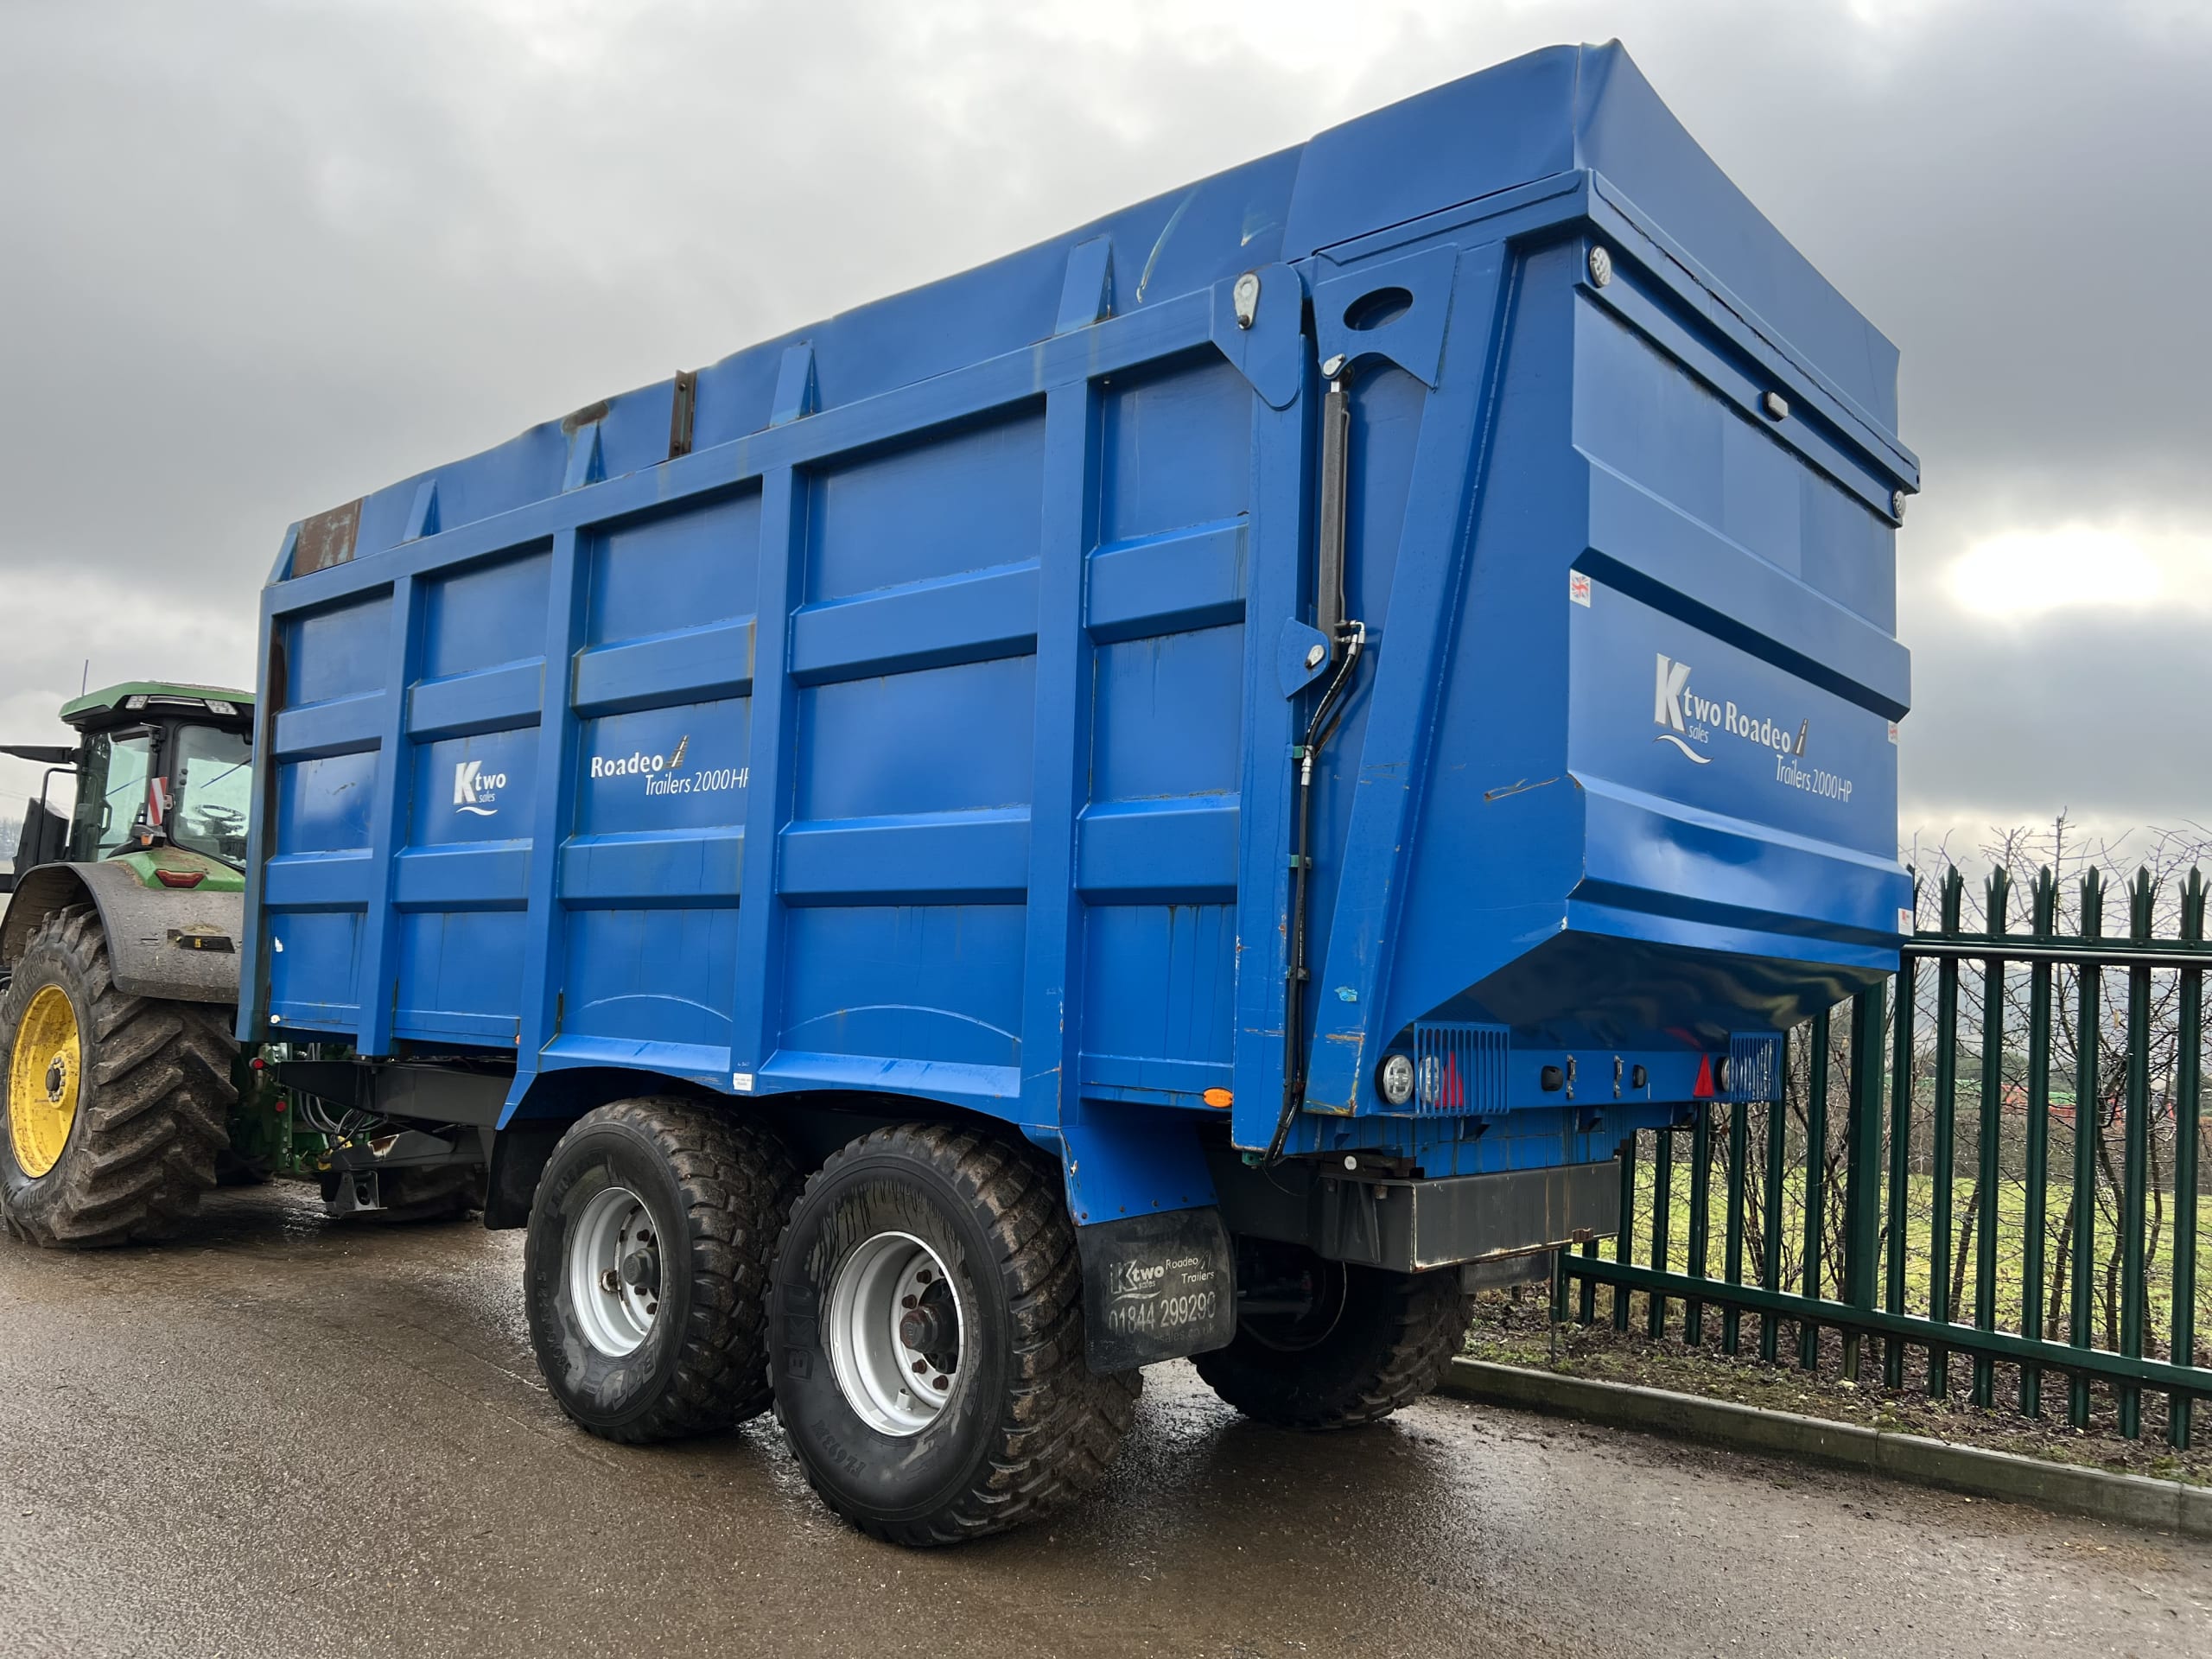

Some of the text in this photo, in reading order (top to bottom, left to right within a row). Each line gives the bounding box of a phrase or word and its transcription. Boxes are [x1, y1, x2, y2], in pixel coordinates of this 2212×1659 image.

[1654, 652, 1791, 753] Ktwo Roadeo
[1688, 722, 1709, 744] sales
[590, 752, 664, 778] Roadeo
[453, 760, 506, 805] Ktwo
[645, 774, 691, 796] Trailers
[1776, 753, 1853, 803] Trailers 2000HP
[479, 792, 496, 804] sales
[1166, 1255, 1199, 1270] Roadeo
[1138, 1280, 1156, 1290] sales
[1181, 1270, 1215, 1284] Trailers
[1108, 1291, 1217, 1335] 01844 299290
